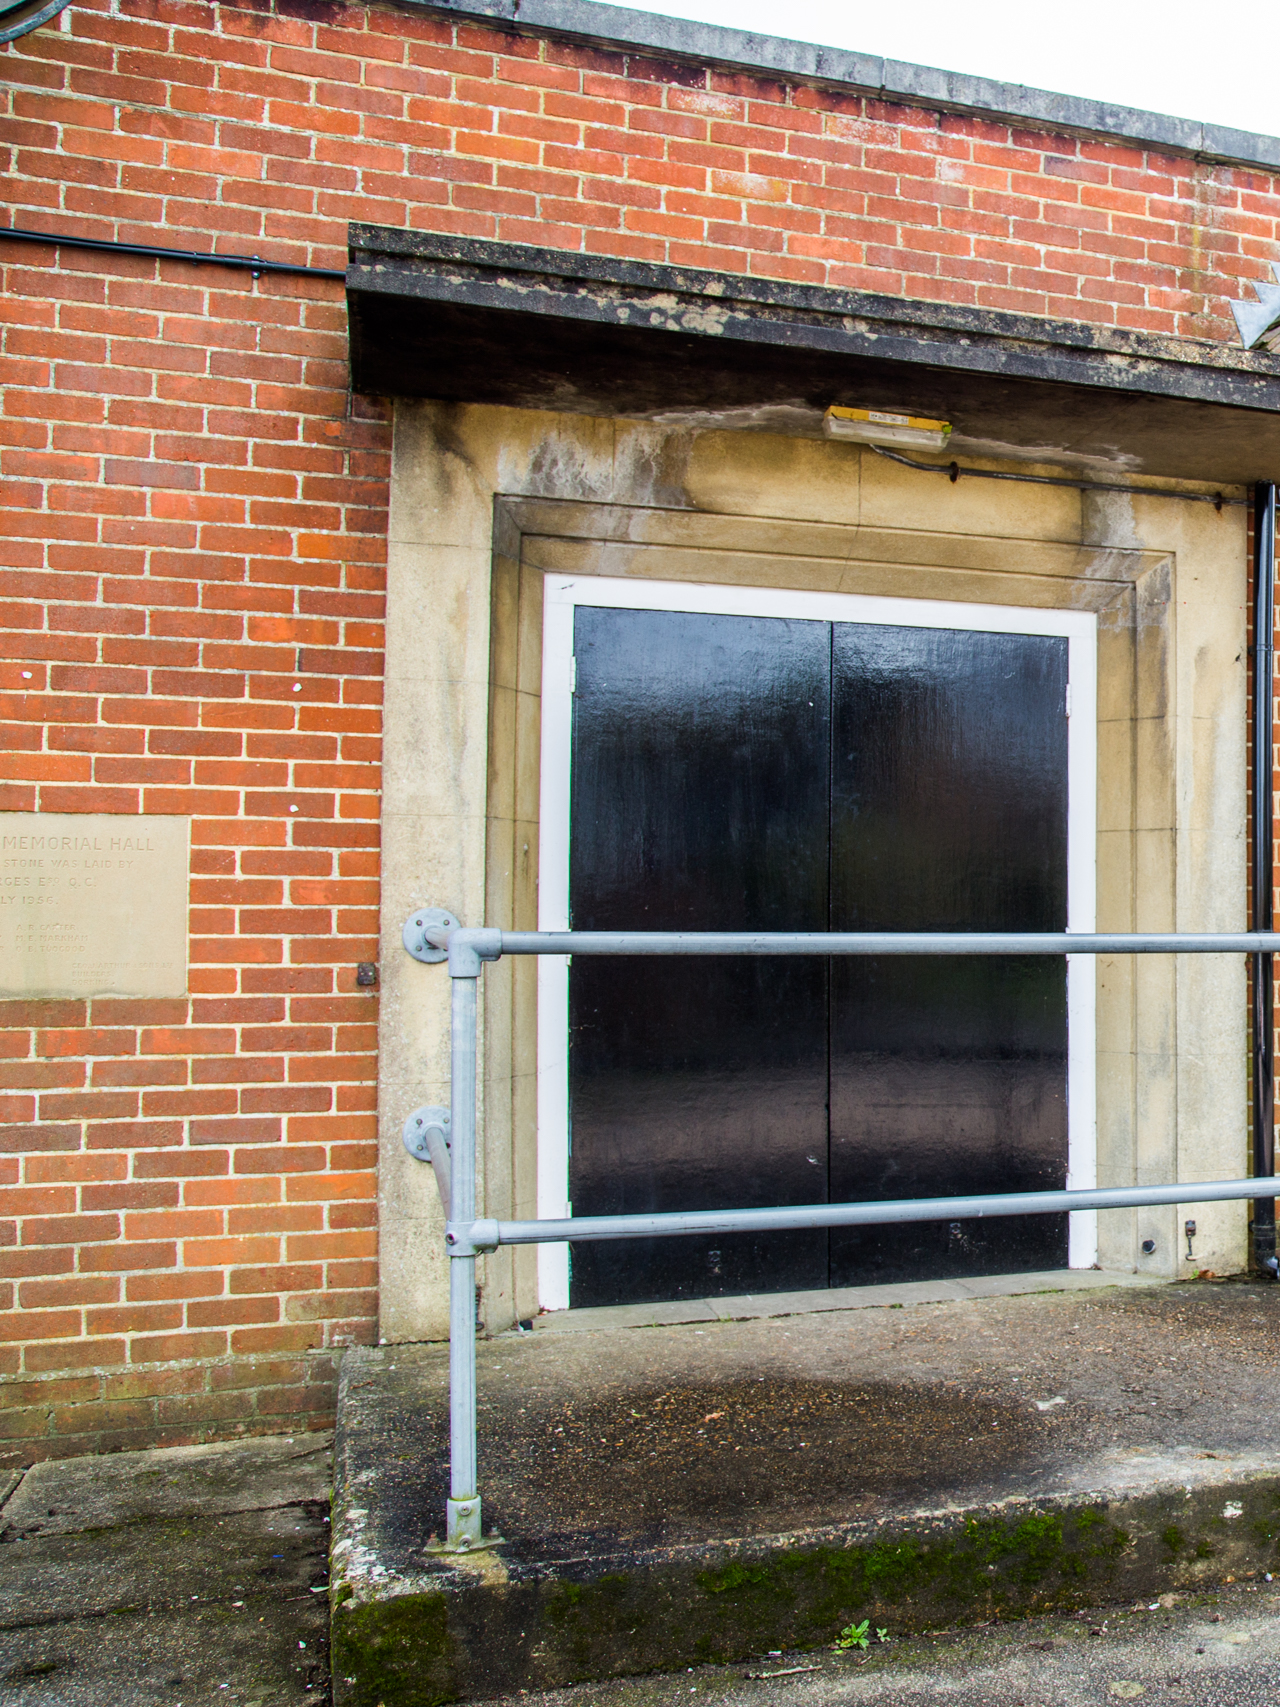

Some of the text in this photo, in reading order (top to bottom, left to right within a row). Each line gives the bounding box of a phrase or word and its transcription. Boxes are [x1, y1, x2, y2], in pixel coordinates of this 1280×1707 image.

[2, 836, 155, 851] MEMORIAL HALL
[3, 859, 134, 869] STONE WAS LAID BY
